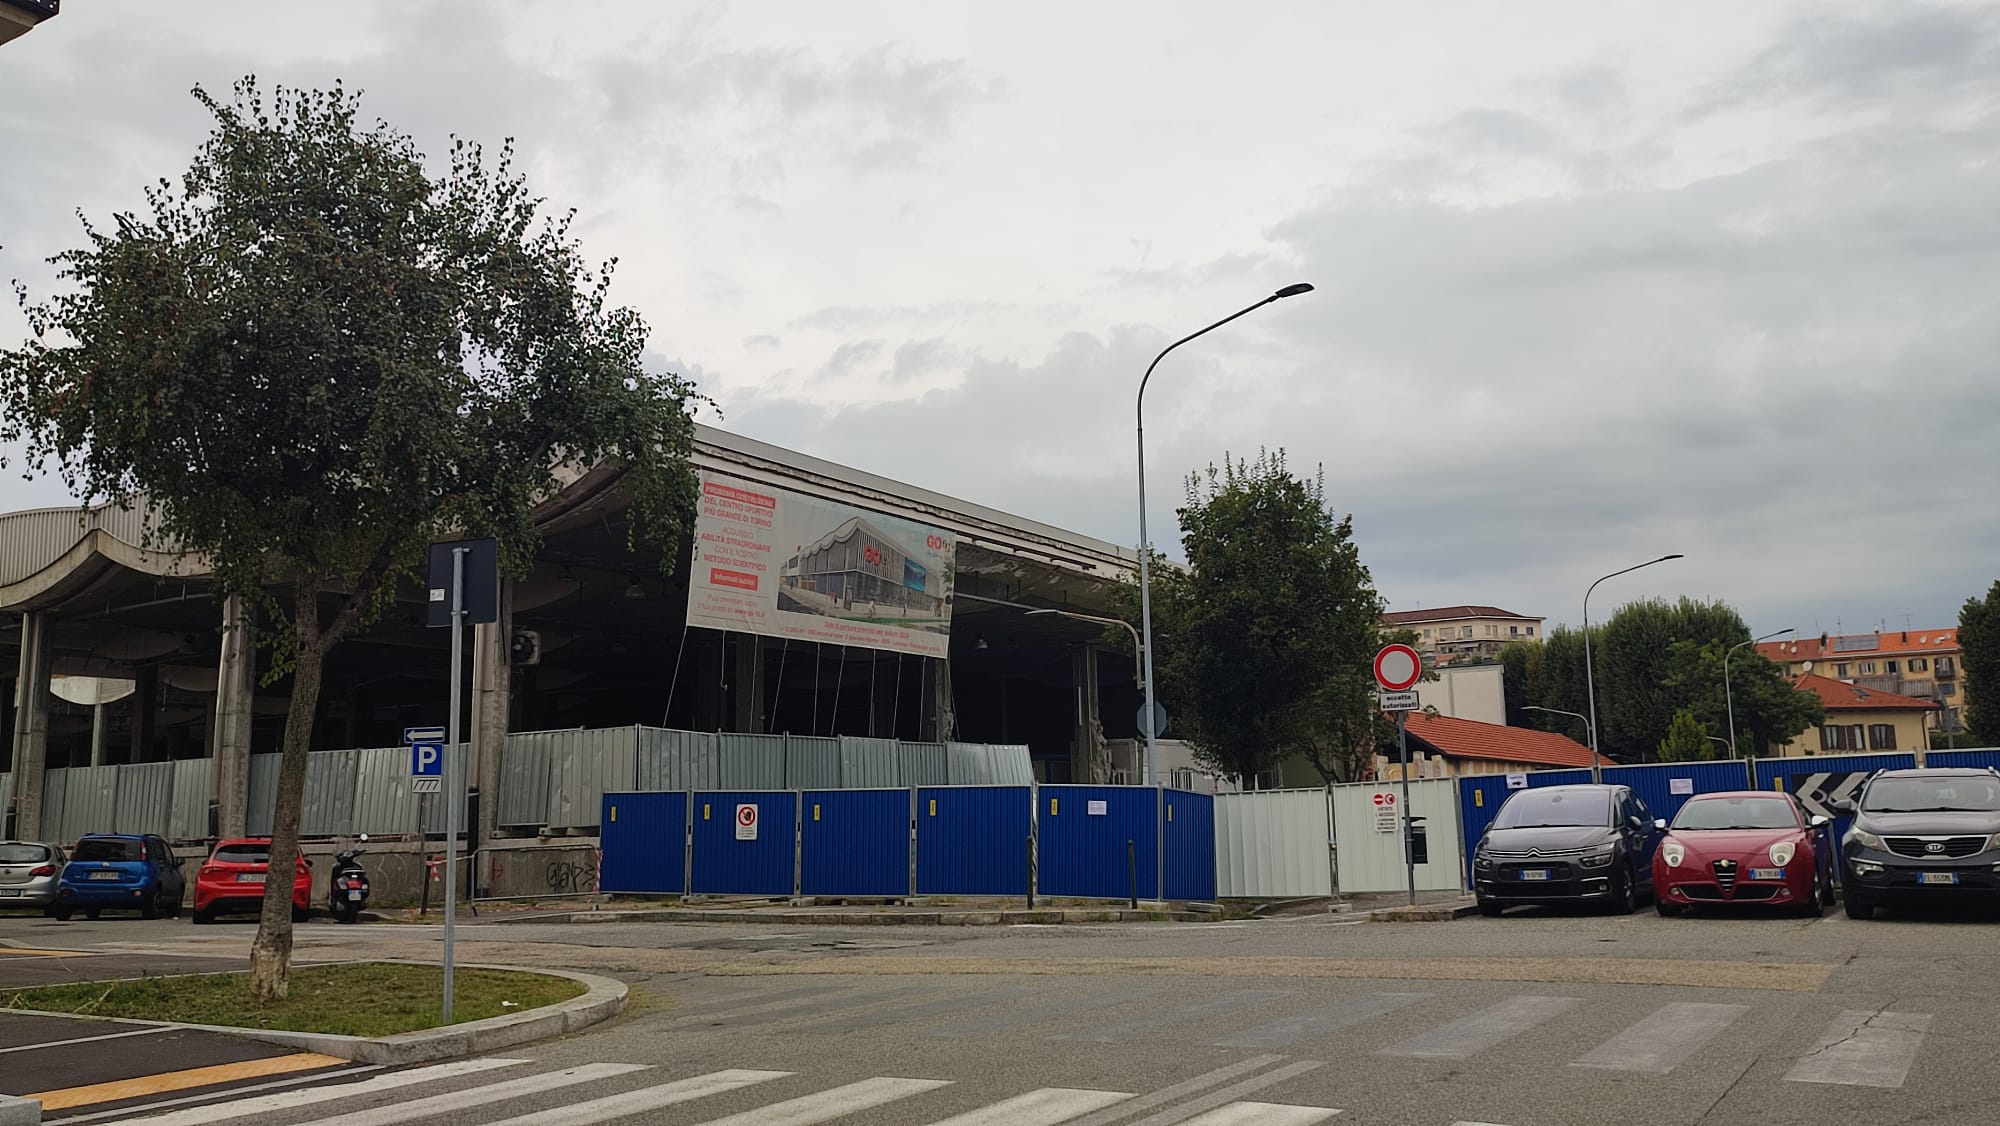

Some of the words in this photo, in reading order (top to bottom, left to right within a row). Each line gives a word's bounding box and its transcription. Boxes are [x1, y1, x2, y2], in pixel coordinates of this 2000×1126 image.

[704, 497, 717, 505] DEL
[719, 499, 743, 511] CENTRO
[744, 505, 773, 518] SPORTIVO
[717, 509, 741, 521] GRANDE
[750, 516, 772, 528] TORINO
[704, 554, 731, 565] METODO
[732, 558, 767, 572] SCIENTIFICO
[418, 746, 437, 773] P
